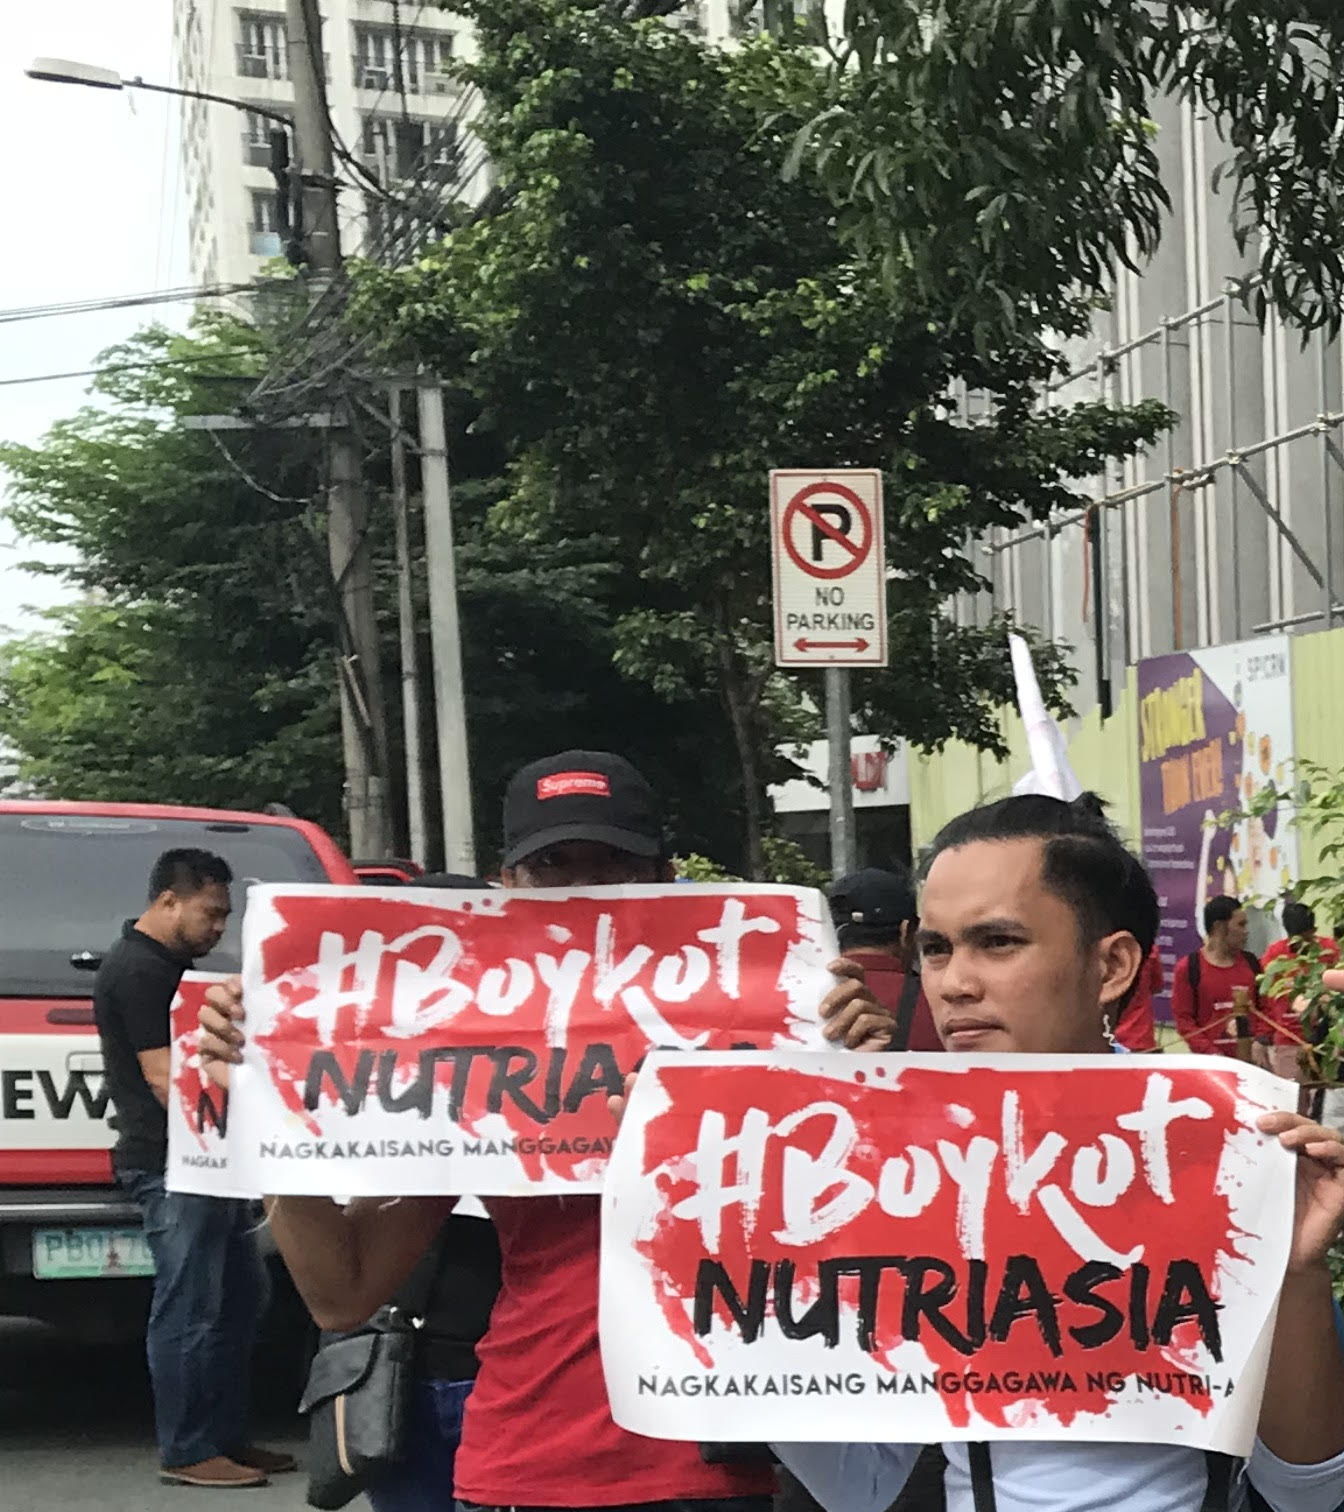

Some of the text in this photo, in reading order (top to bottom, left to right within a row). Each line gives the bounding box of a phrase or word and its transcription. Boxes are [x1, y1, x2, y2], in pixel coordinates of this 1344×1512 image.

[786, 612, 875, 631] PARKING
[815, 586, 845, 607] NO
[292, 897, 781, 1051] #Boykot
[303, 1043, 648, 1125] NUTRIA
[259, 1138, 454, 1159] NAGKAKAISANG
[672, 1071, 1215, 1268] #Boykot
[693, 1254, 1224, 1364] NUTRIASIA
[637, 1373, 866, 1398] NAGKAKAISANG
[876, 1371, 1075, 1396] MANGGAGAWA
[1087, 1372, 1125, 1396] NG
